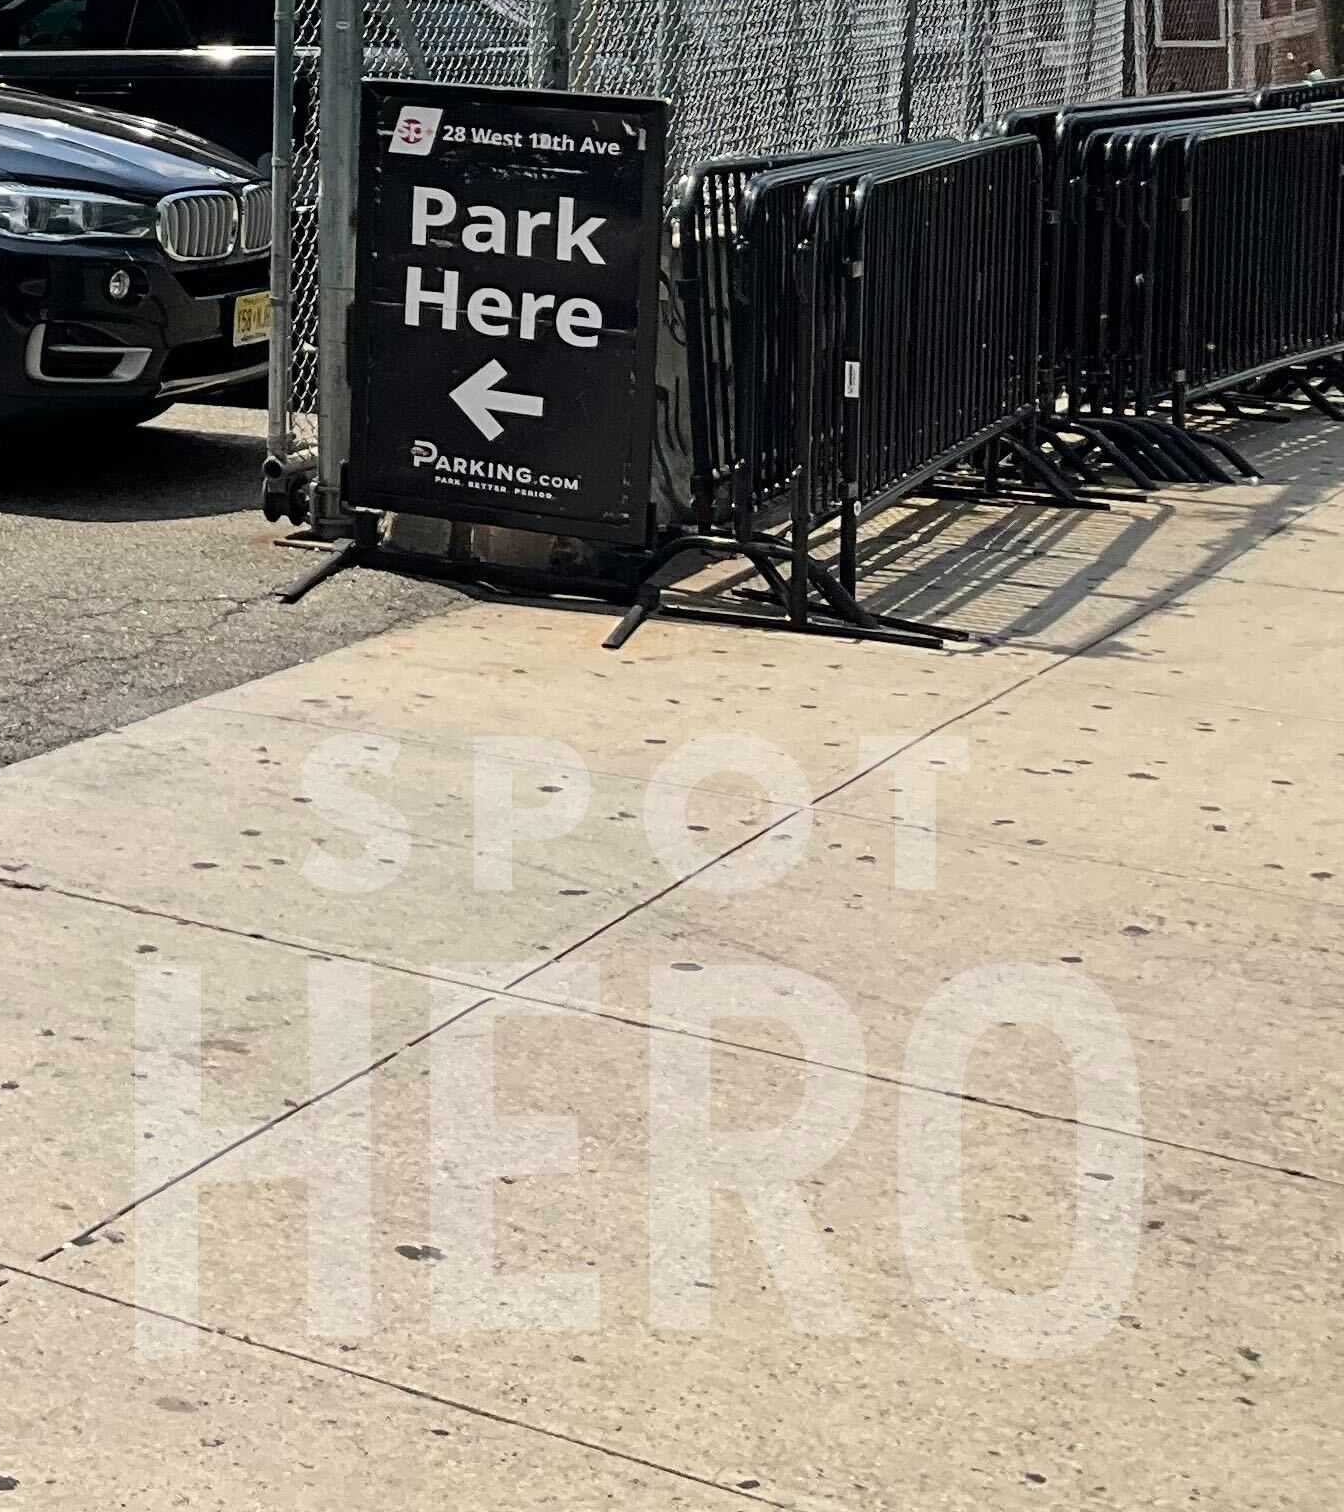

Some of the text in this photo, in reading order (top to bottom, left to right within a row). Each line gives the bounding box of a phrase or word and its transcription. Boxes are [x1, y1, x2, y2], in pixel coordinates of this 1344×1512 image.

[443, 124, 466, 143] 28
[471, 128, 522, 148] West
[579, 136, 622, 155] Ave
[410, 185, 607, 265] Park
[404, 265, 603, 349] Here
